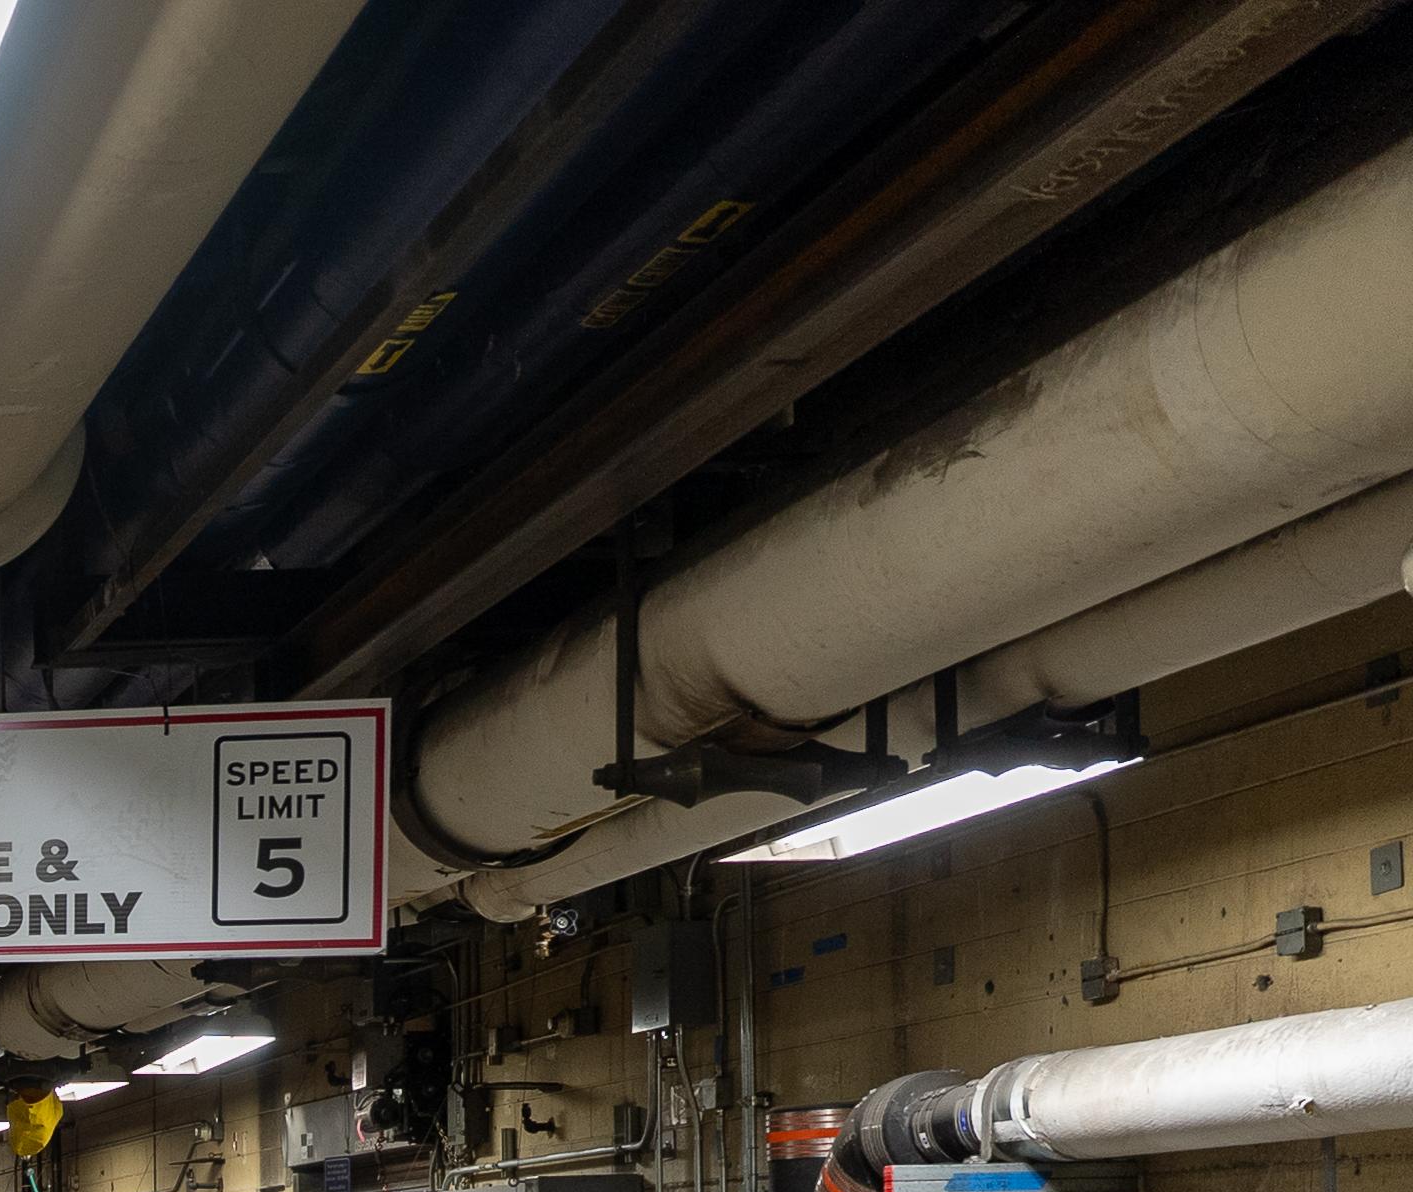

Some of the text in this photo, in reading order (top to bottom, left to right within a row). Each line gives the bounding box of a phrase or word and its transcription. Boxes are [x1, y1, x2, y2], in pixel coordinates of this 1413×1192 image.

[226, 758, 339, 788] SPEED
[237, 792, 326, 820] LIMIT
[35, 838, 80, 883] &
[253, 837, 306, 899] 5
